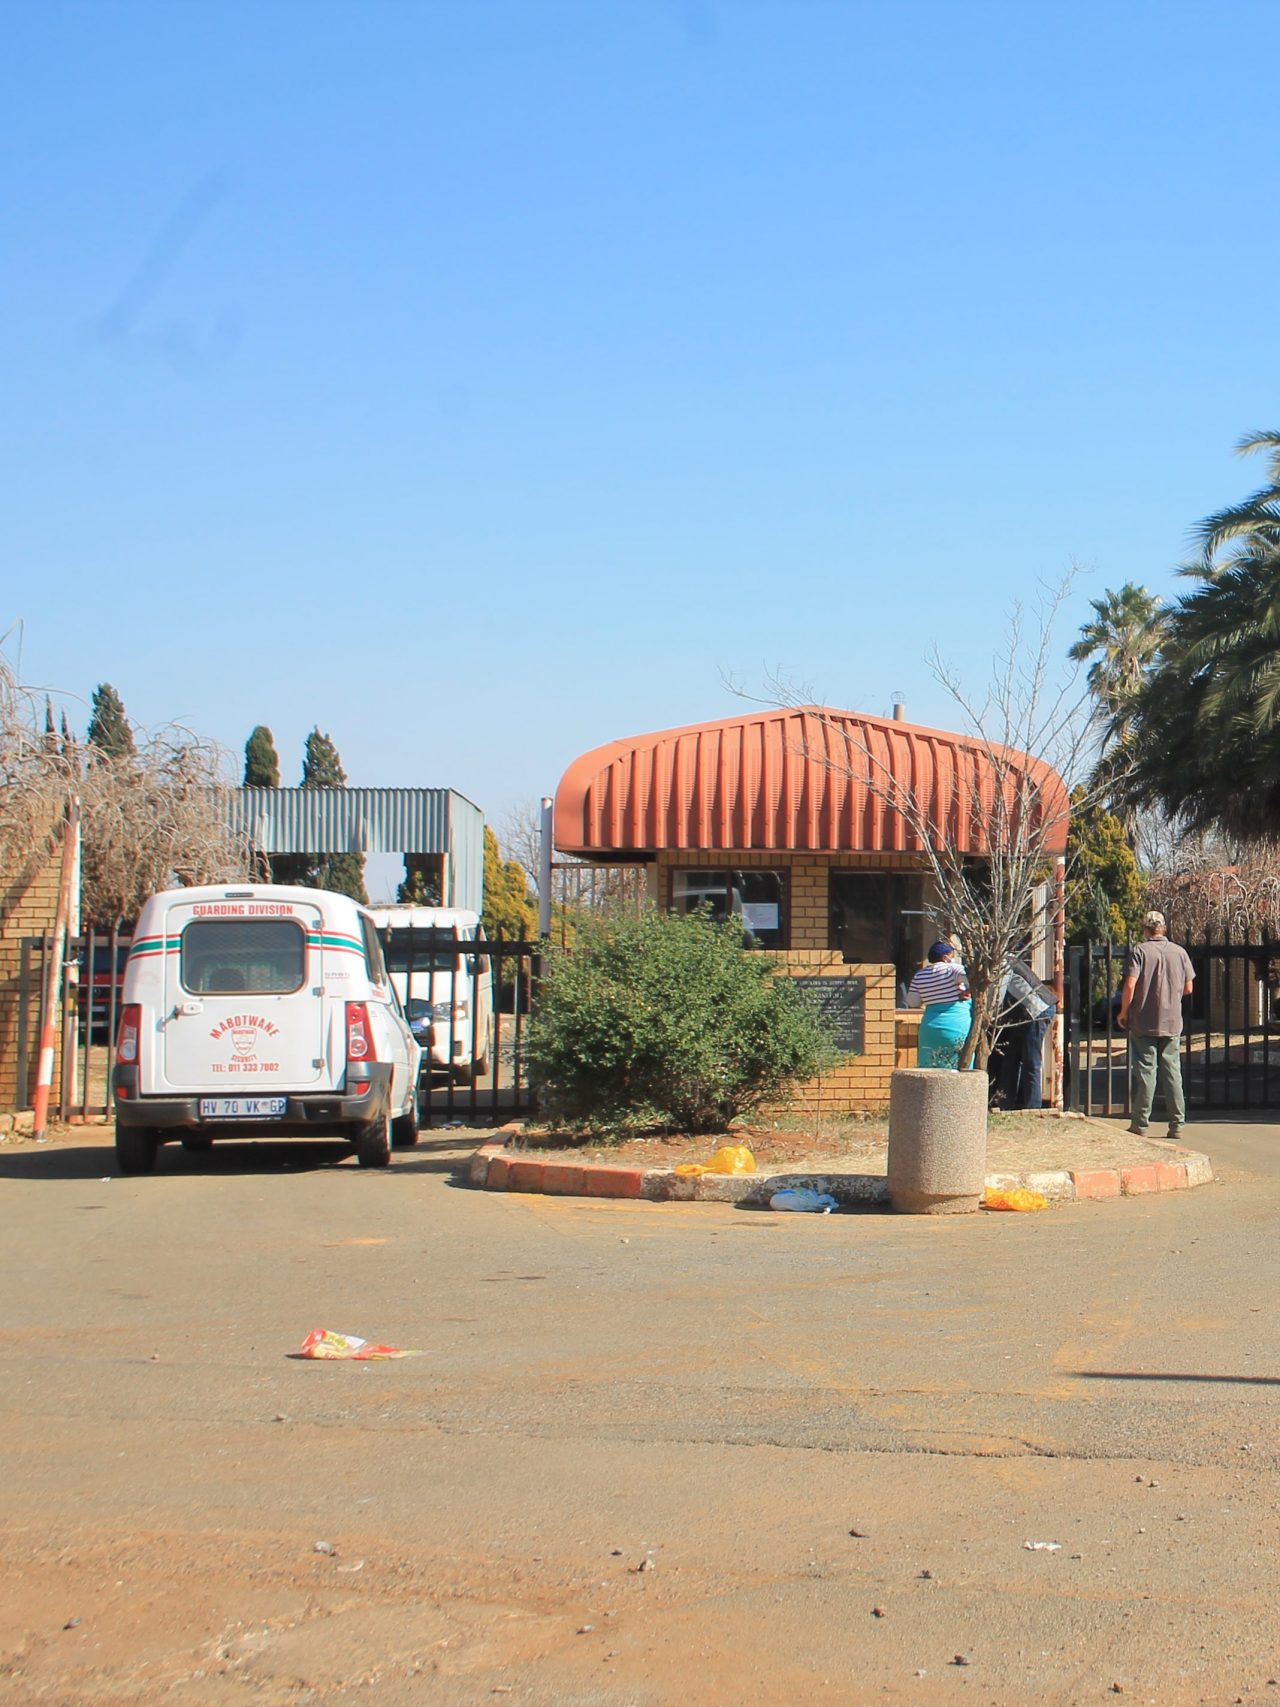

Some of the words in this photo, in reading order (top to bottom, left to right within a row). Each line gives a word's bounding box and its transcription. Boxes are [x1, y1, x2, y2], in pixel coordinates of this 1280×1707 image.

[193, 905, 245, 915] GUARDING
[248, 905, 293, 915] DIVISION
[209, 1015, 280, 1039] MABOTWANE
[212, 1064, 226, 1072] TEL:
[228, 1063, 240, 1072] 011
[202, 1101, 217, 1114] HV
[224, 1101, 238, 1113] 70
[246, 1101, 260, 1113] VK
[270, 1100, 285, 1112] GP
